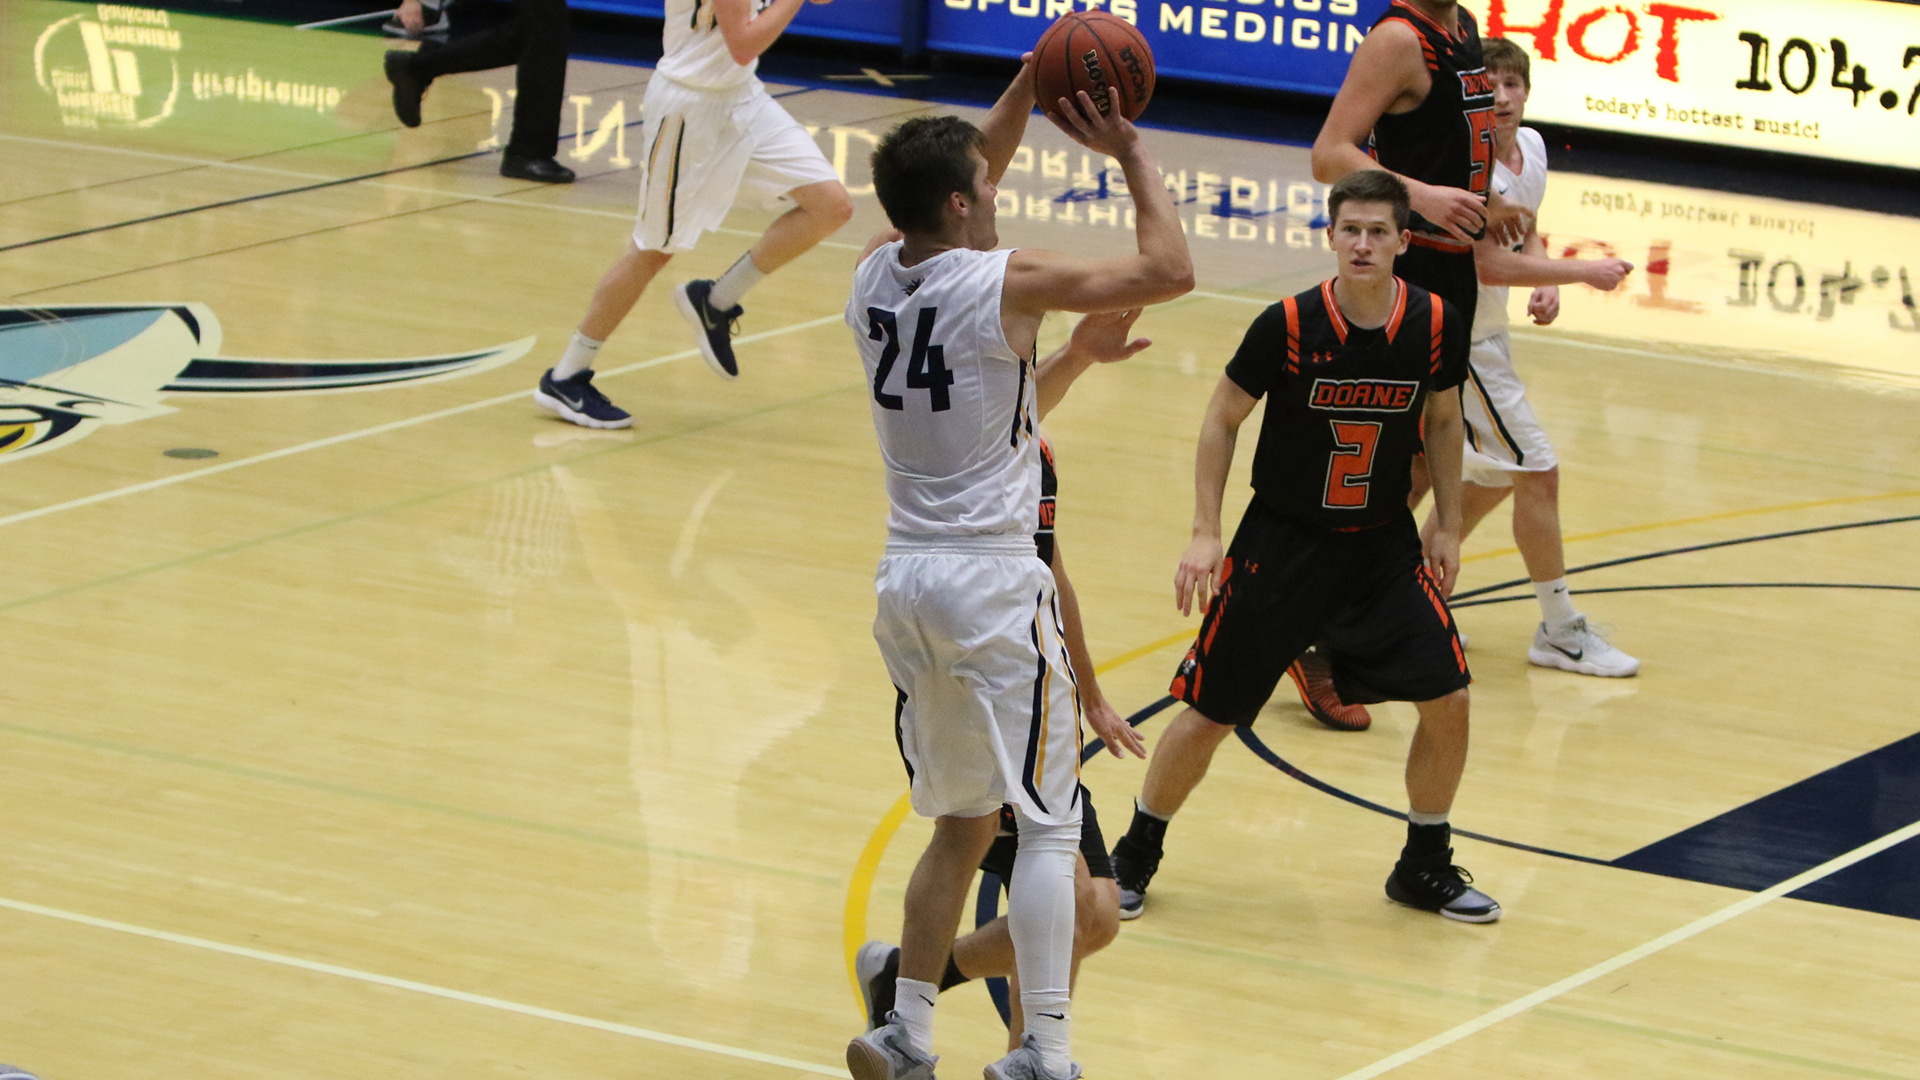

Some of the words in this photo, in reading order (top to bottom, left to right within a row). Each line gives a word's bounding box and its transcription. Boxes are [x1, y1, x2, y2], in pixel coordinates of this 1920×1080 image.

[1159, 3, 1371, 53] MEDICIN
[1486, 0, 1724, 83] HOT
[1585, 95, 1657, 120] today's
[1666, 103, 1744, 130] hottest
[1754, 118, 1820, 139] music!
[867, 306, 954, 412] 24
[1312, 382, 1414, 409] DOANE
[1322, 419, 1383, 509] 2
